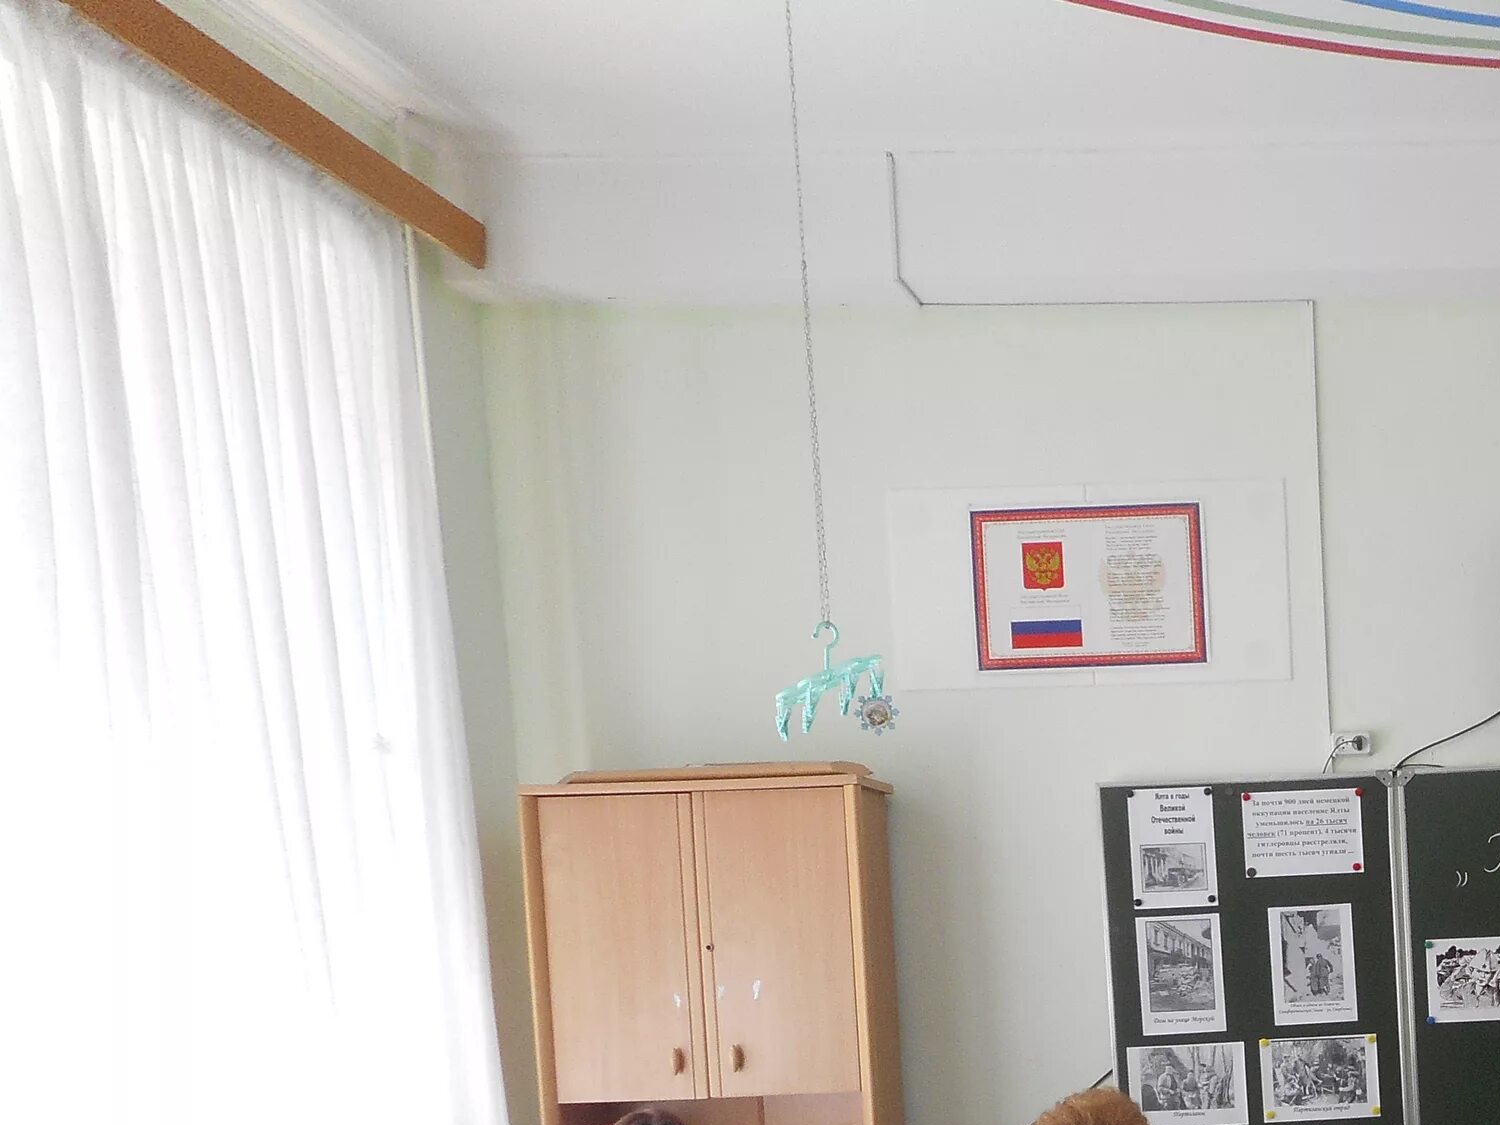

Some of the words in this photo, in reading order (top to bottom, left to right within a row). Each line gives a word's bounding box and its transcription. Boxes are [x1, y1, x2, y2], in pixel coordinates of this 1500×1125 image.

[1159, 804, 1186, 812] Великой
[1292, 808, 1329, 816] население
[1151, 814, 1196, 824] Отечественной
[1164, 827, 1184, 835] войны
